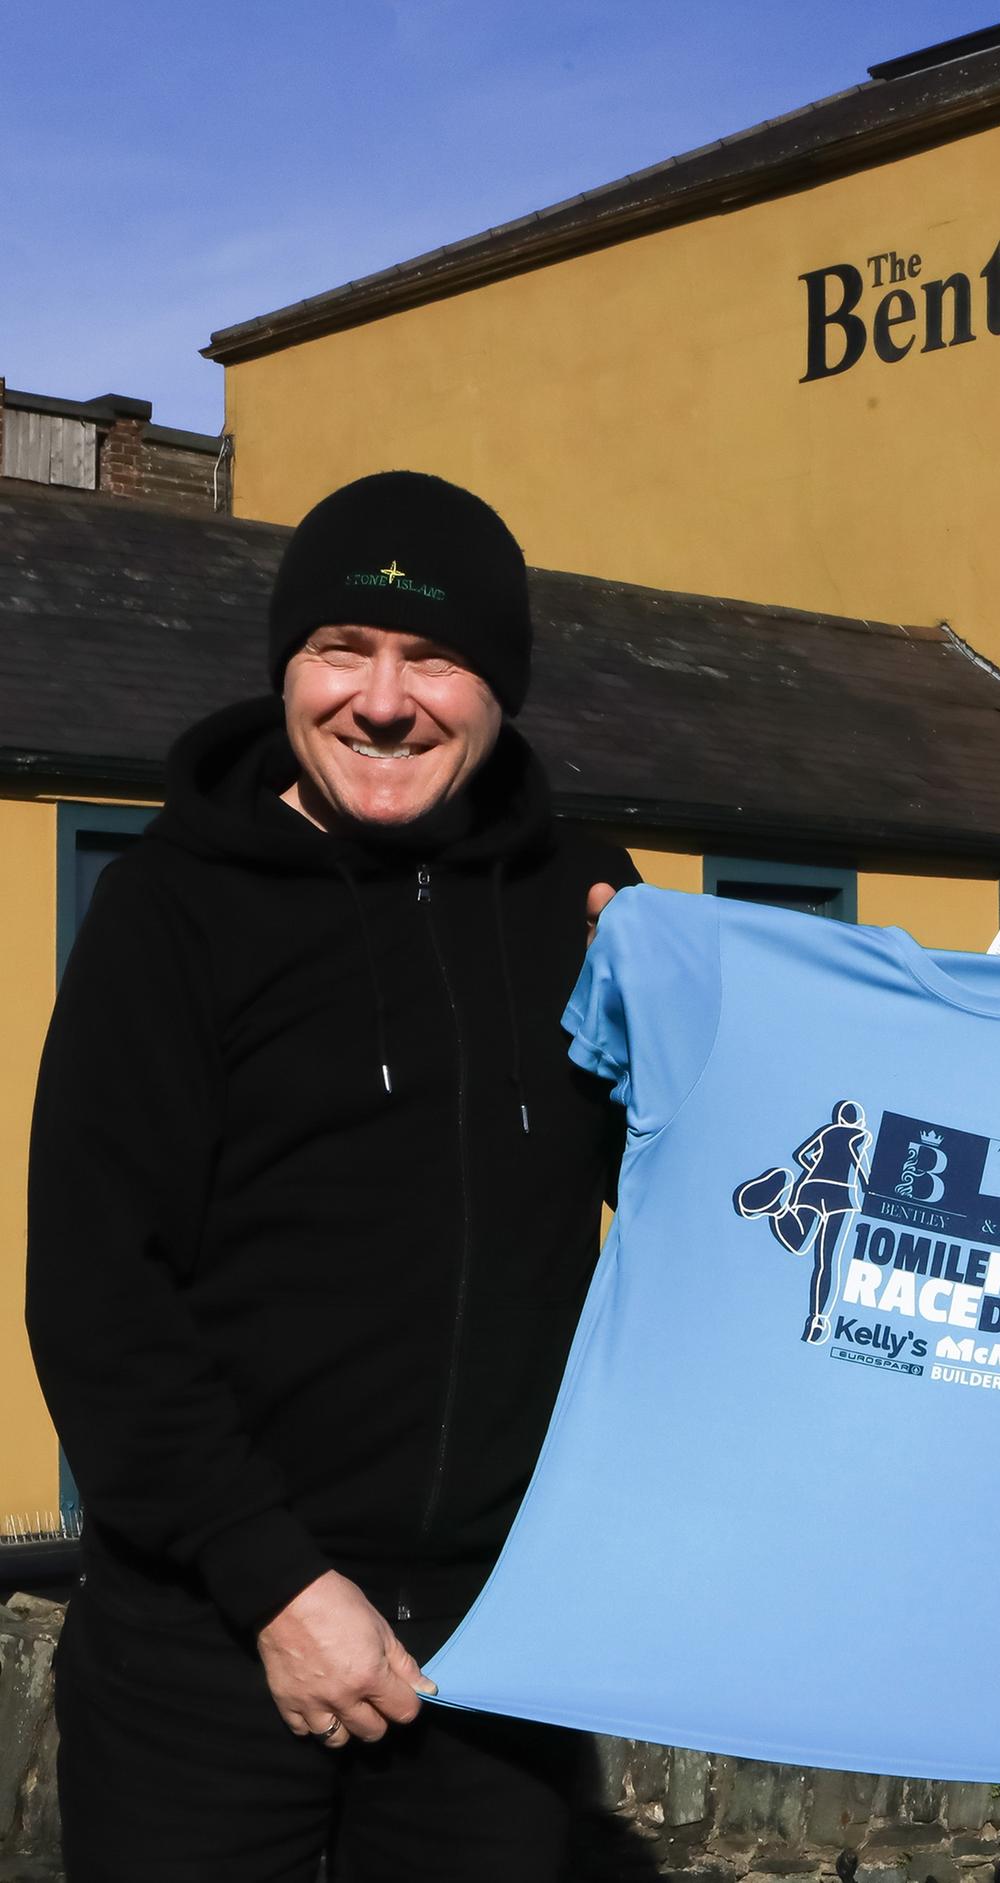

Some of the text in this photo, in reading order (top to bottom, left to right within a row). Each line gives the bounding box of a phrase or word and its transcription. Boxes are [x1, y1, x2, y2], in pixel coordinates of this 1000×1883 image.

[867, 251, 922, 288] The
[396, 578, 447, 601] ISLAND
[881, 1202, 949, 1229] BENTLEY
[981, 1218, 997, 1234] &
[842, 1258, 985, 1329] RACE
[834, 1315, 929, 1358] Kelly's
[839, 1351, 909, 1372] EUROSPAR
